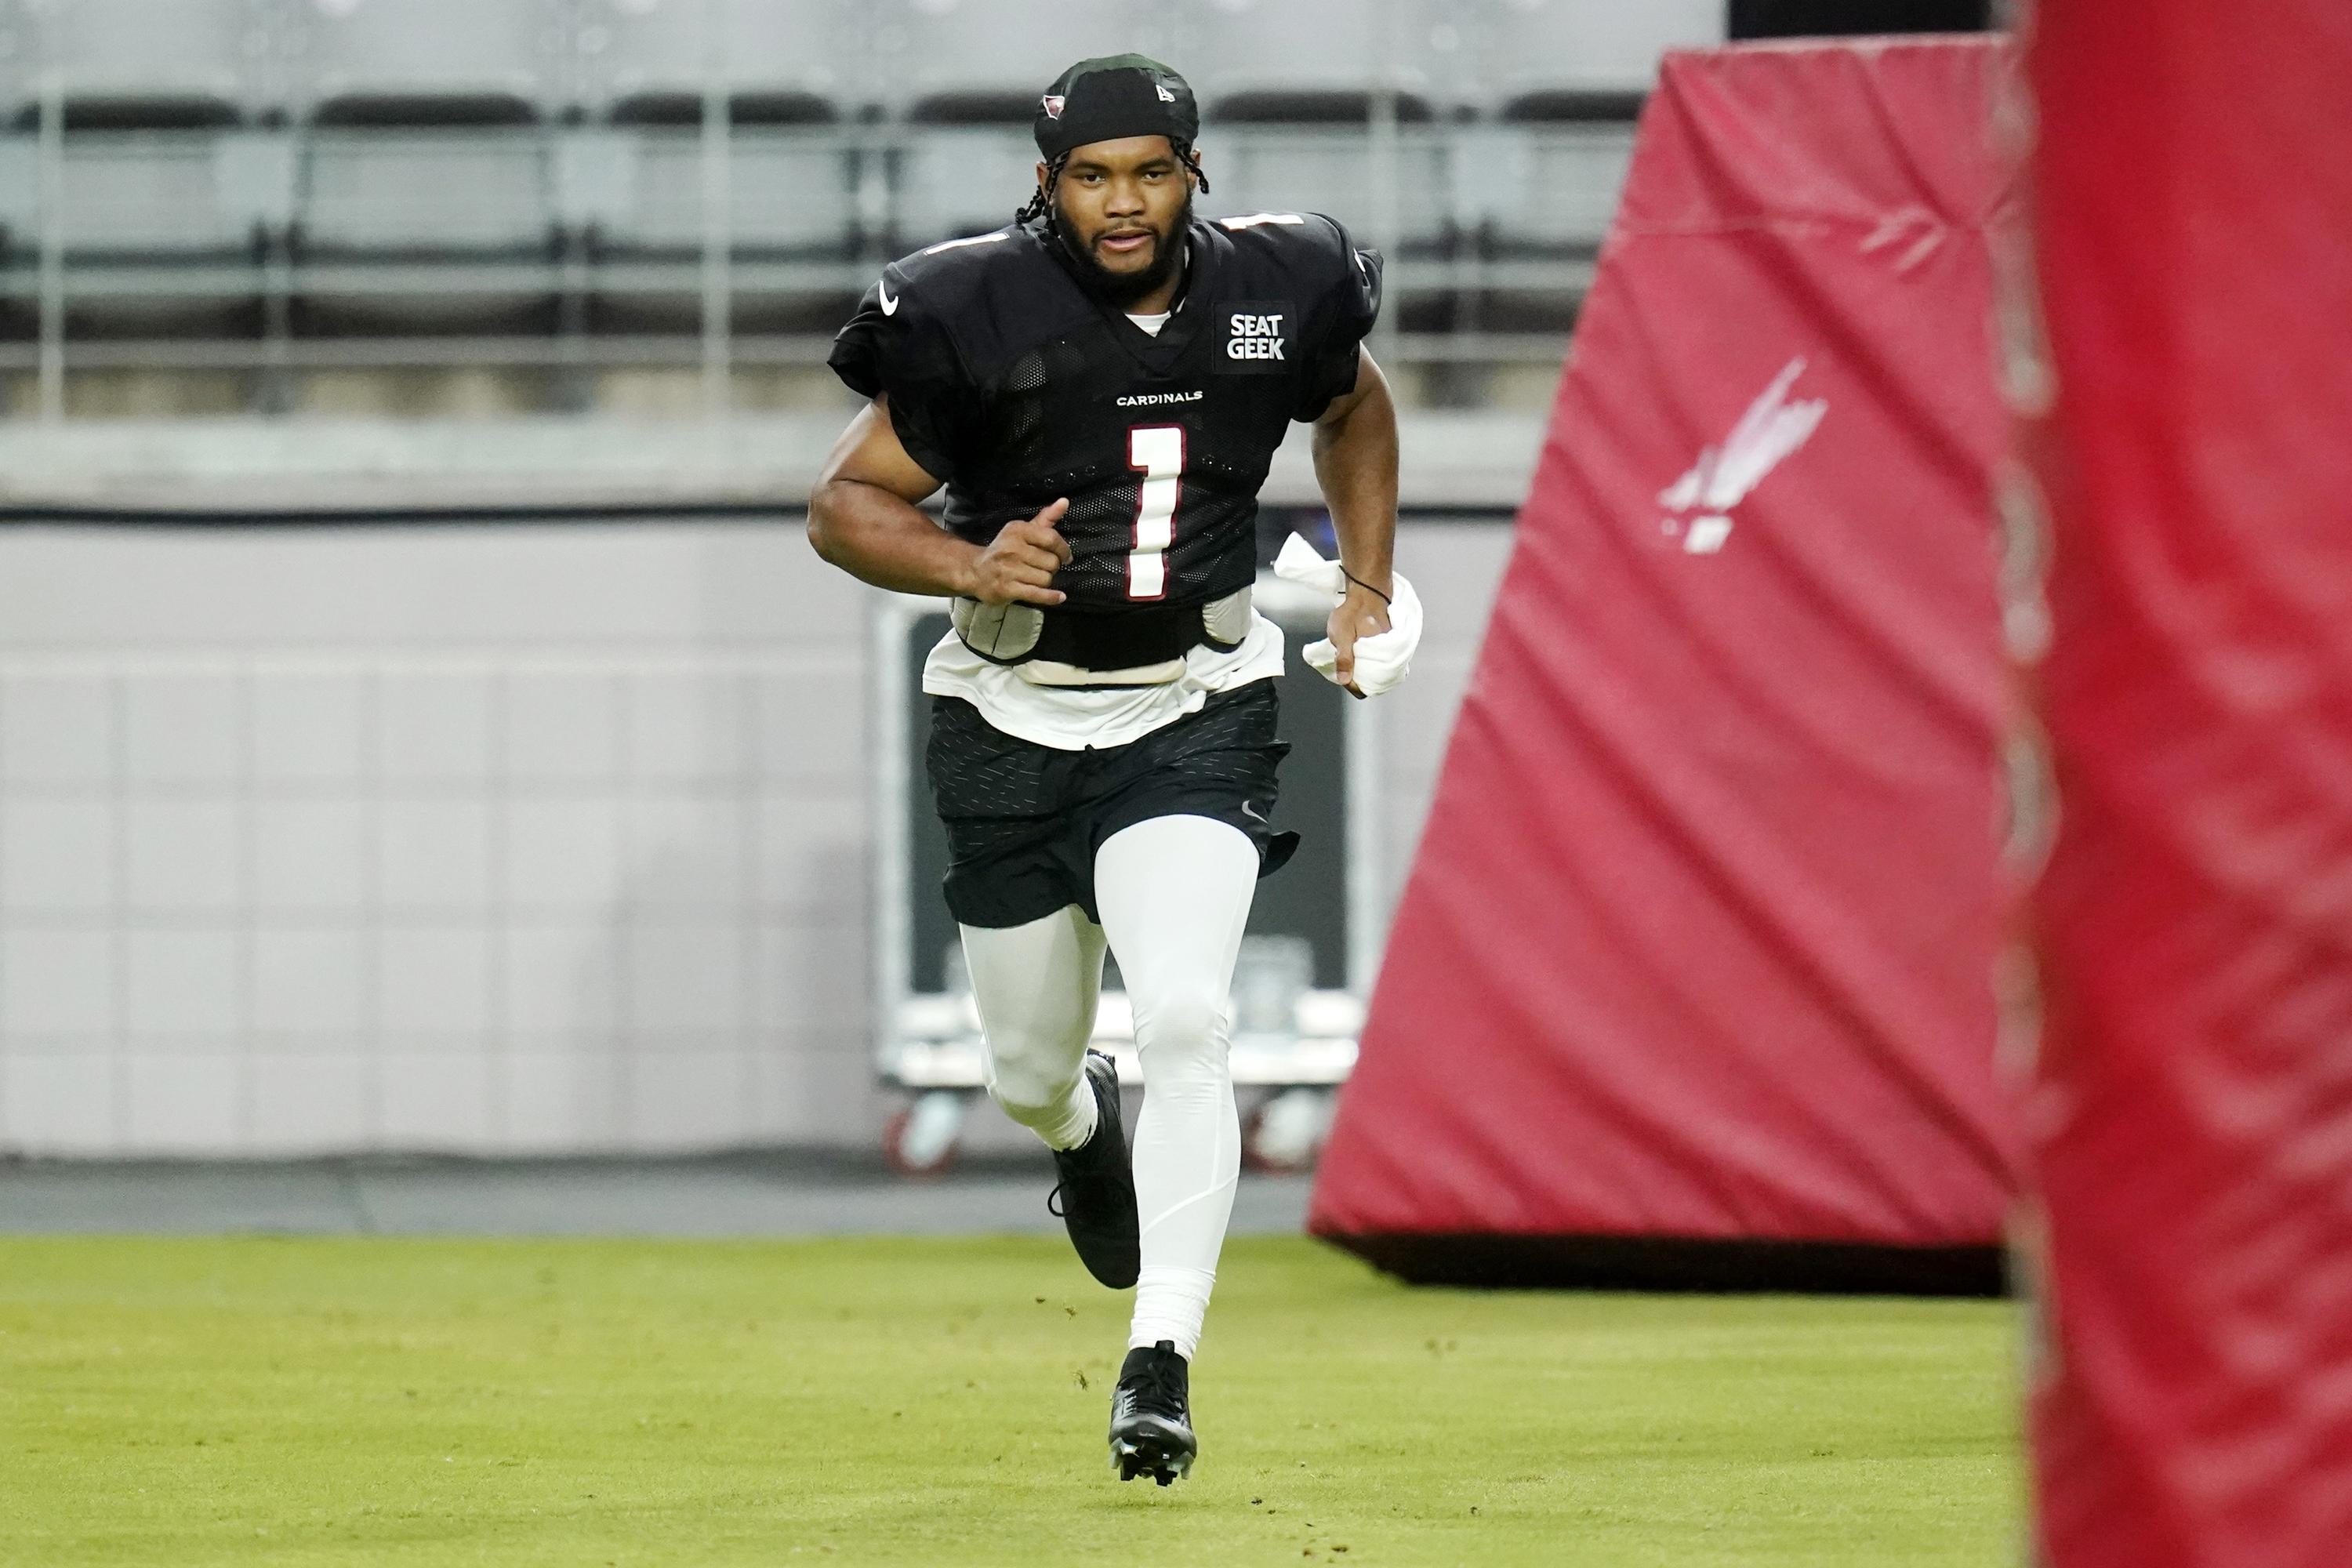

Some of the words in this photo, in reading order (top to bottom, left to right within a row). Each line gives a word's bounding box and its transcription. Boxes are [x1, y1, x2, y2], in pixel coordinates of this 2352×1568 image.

[1230, 314, 1283, 336] SEAT
[1226, 337, 1285, 361] GEEK
[1116, 390, 1203, 407] CARDINALS
[1125, 423, 1186, 601] 1
